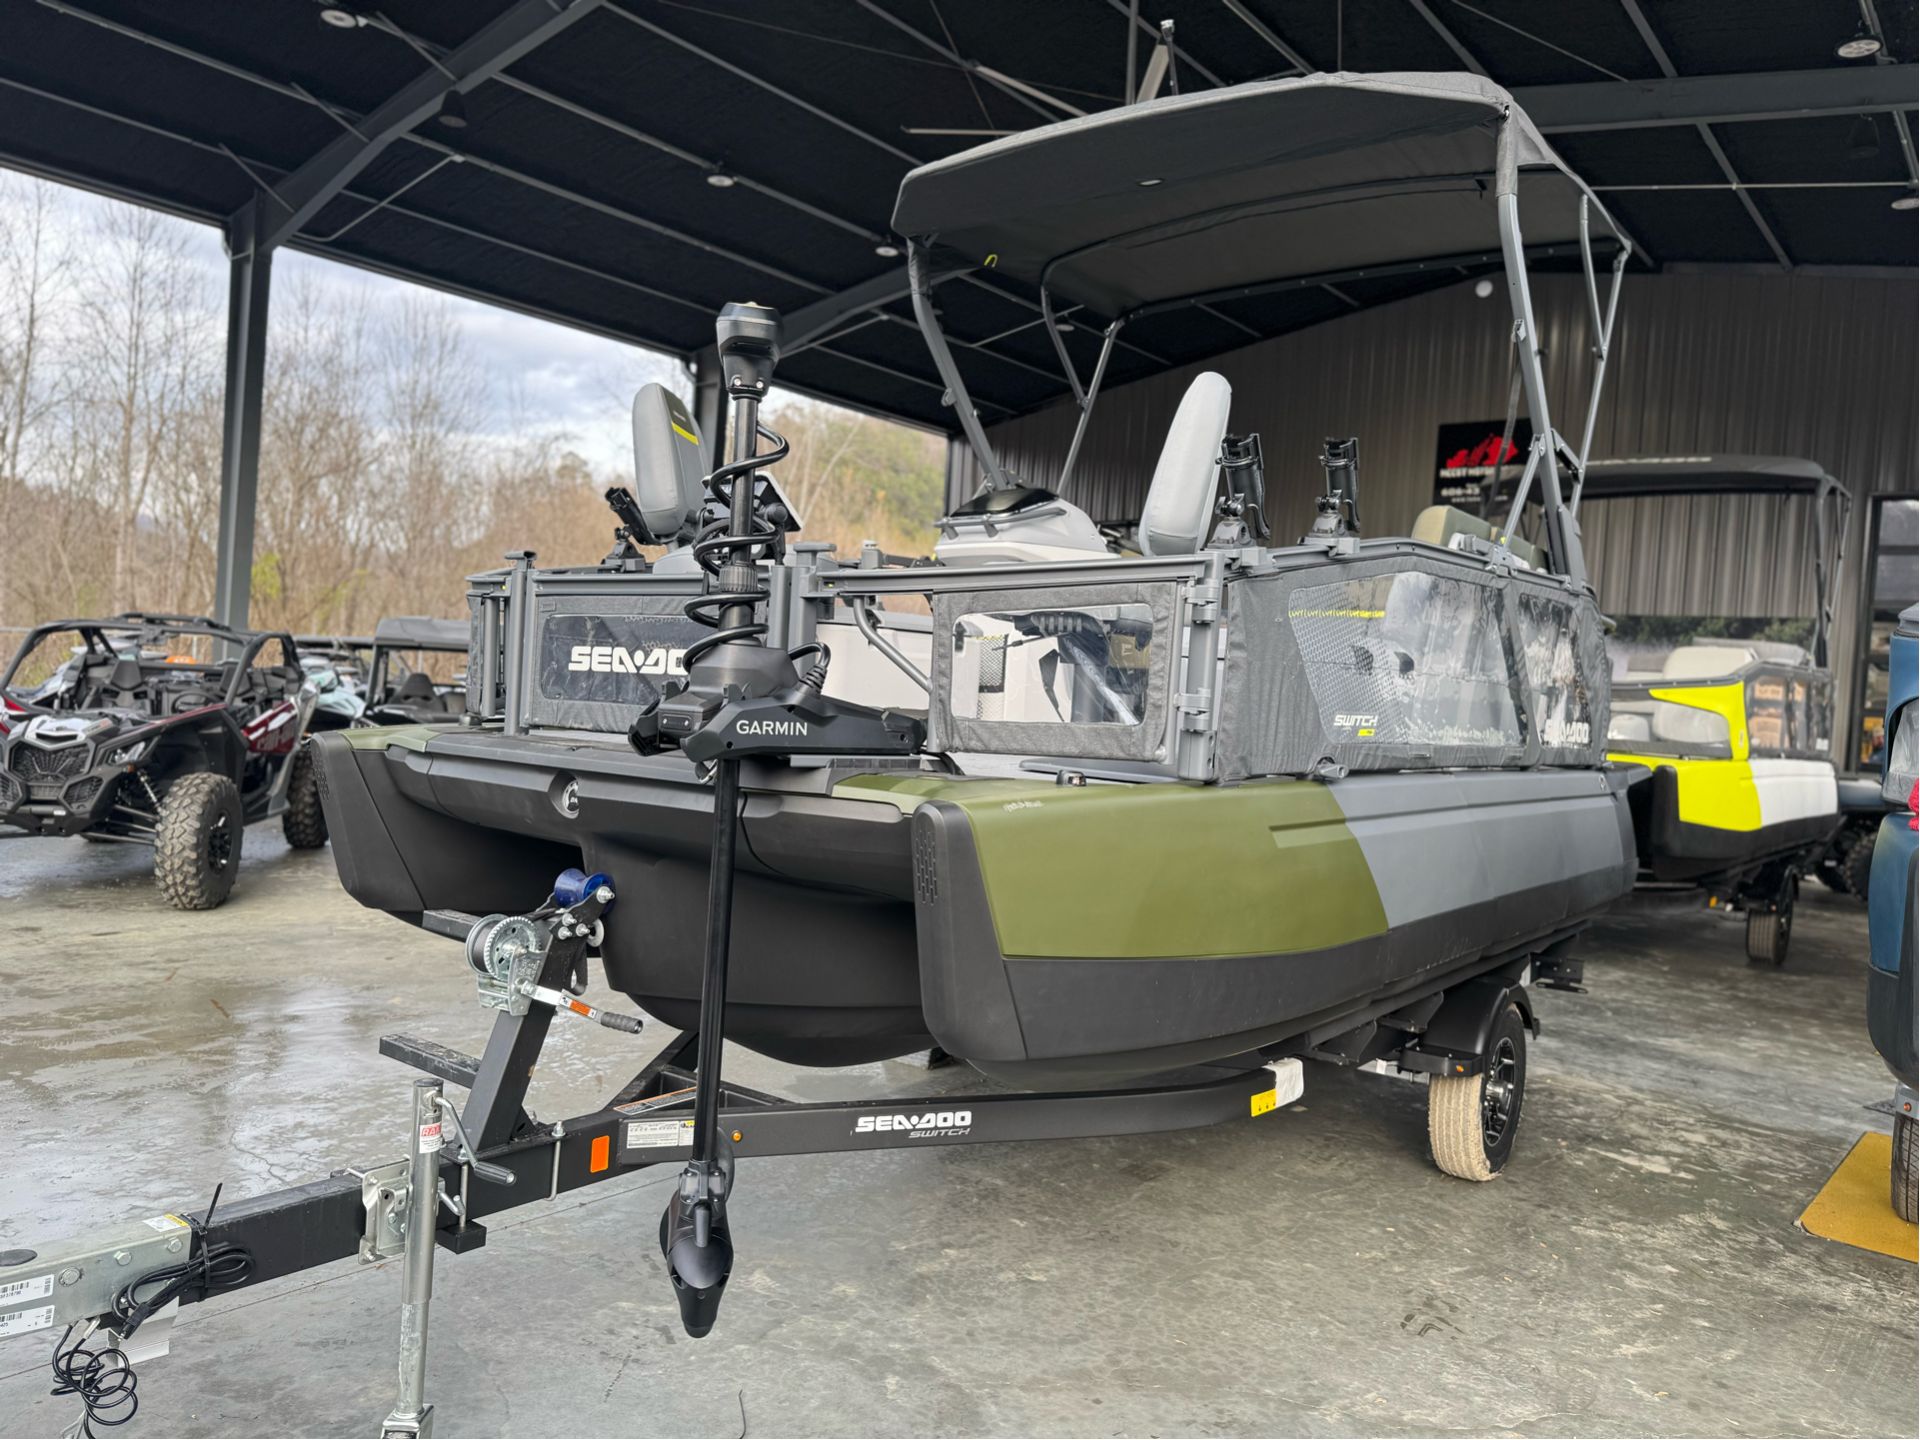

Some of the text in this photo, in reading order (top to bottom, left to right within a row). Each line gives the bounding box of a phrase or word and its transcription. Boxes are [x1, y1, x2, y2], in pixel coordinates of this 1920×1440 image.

[1333, 714, 1378, 726] SWITCH
[736, 719, 808, 736] GARMIN
[908, 1127, 971, 1138] SWITCH
